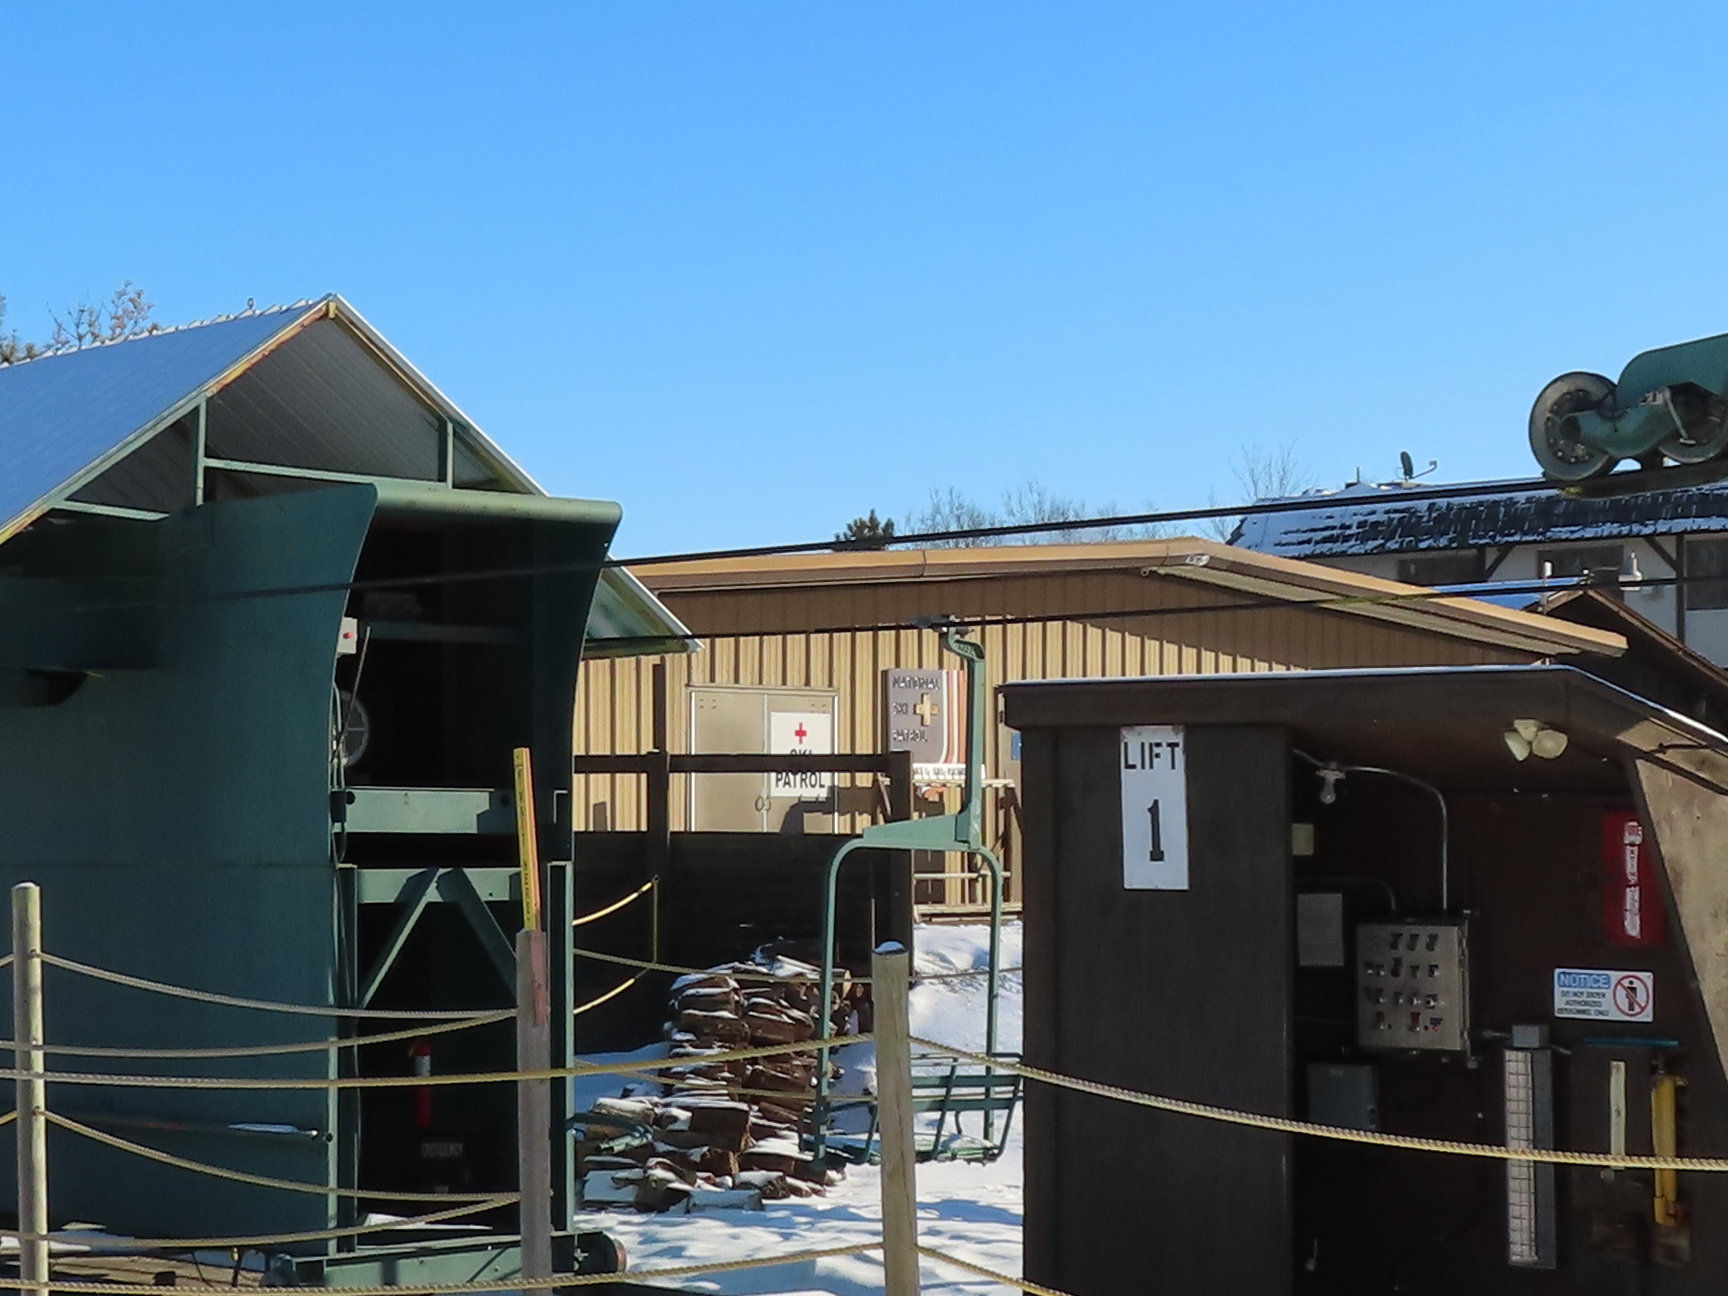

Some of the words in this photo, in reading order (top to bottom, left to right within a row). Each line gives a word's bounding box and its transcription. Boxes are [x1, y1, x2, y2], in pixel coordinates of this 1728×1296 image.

[892, 675, 940, 691] NATIONAL
[892, 702, 908, 715] SKI
[892, 728, 928, 742] PATROL
[1124, 741, 1180, 770] LIFT
[775, 772, 826, 789] PATROL
[1147, 799, 1164, 862] 1
[1560, 974, 1609, 988] NOTICE
